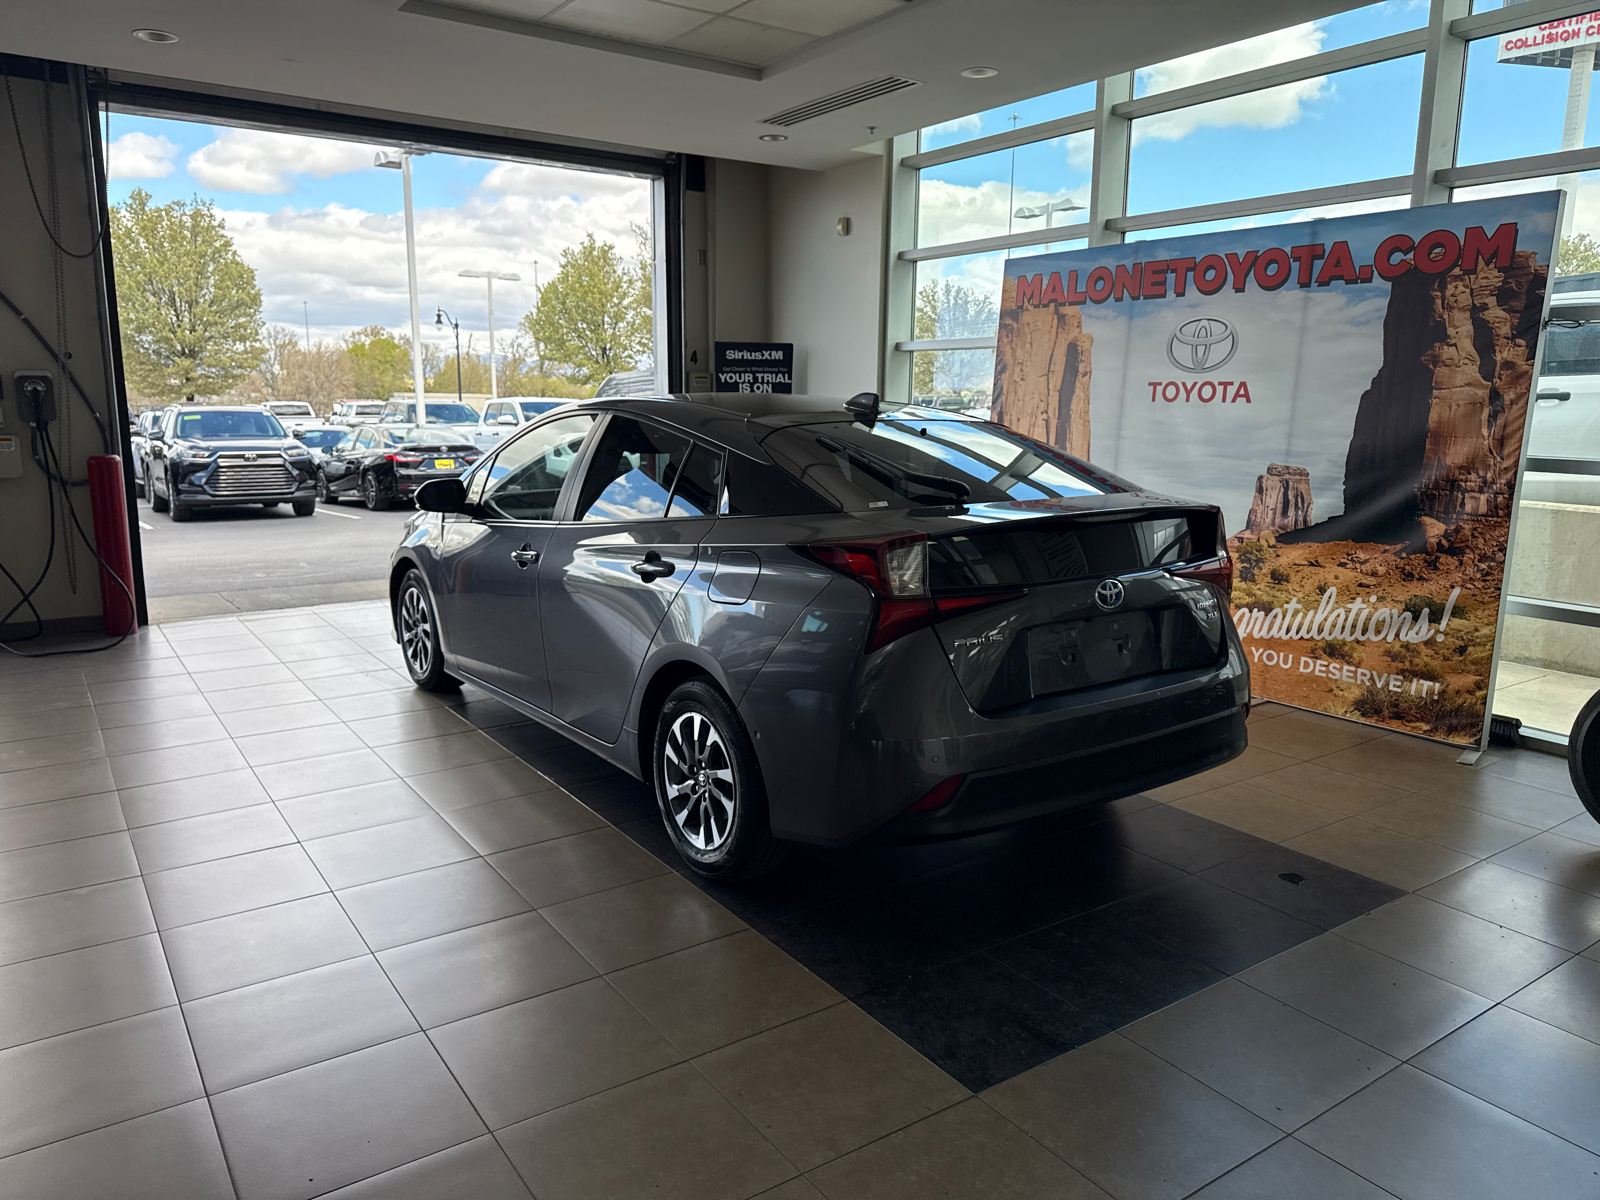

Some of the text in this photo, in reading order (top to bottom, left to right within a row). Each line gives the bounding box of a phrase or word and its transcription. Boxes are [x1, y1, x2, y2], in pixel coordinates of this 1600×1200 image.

[1504, 27, 1581, 51] COLLISION
[1016, 222, 1518, 309] MALONETOYOTA.COM
[690, 350, 698, 365] 4
[725, 350, 783, 360] SiriusXM
[719, 373, 792, 383] YOUR TRIAL
[739, 383, 772, 394] IS ON
[1148, 380, 1252, 404] TOYOTA
[953, 634, 1003, 648] PRIUS
[1251, 646, 1441, 700] YOU DESERVE IT!
